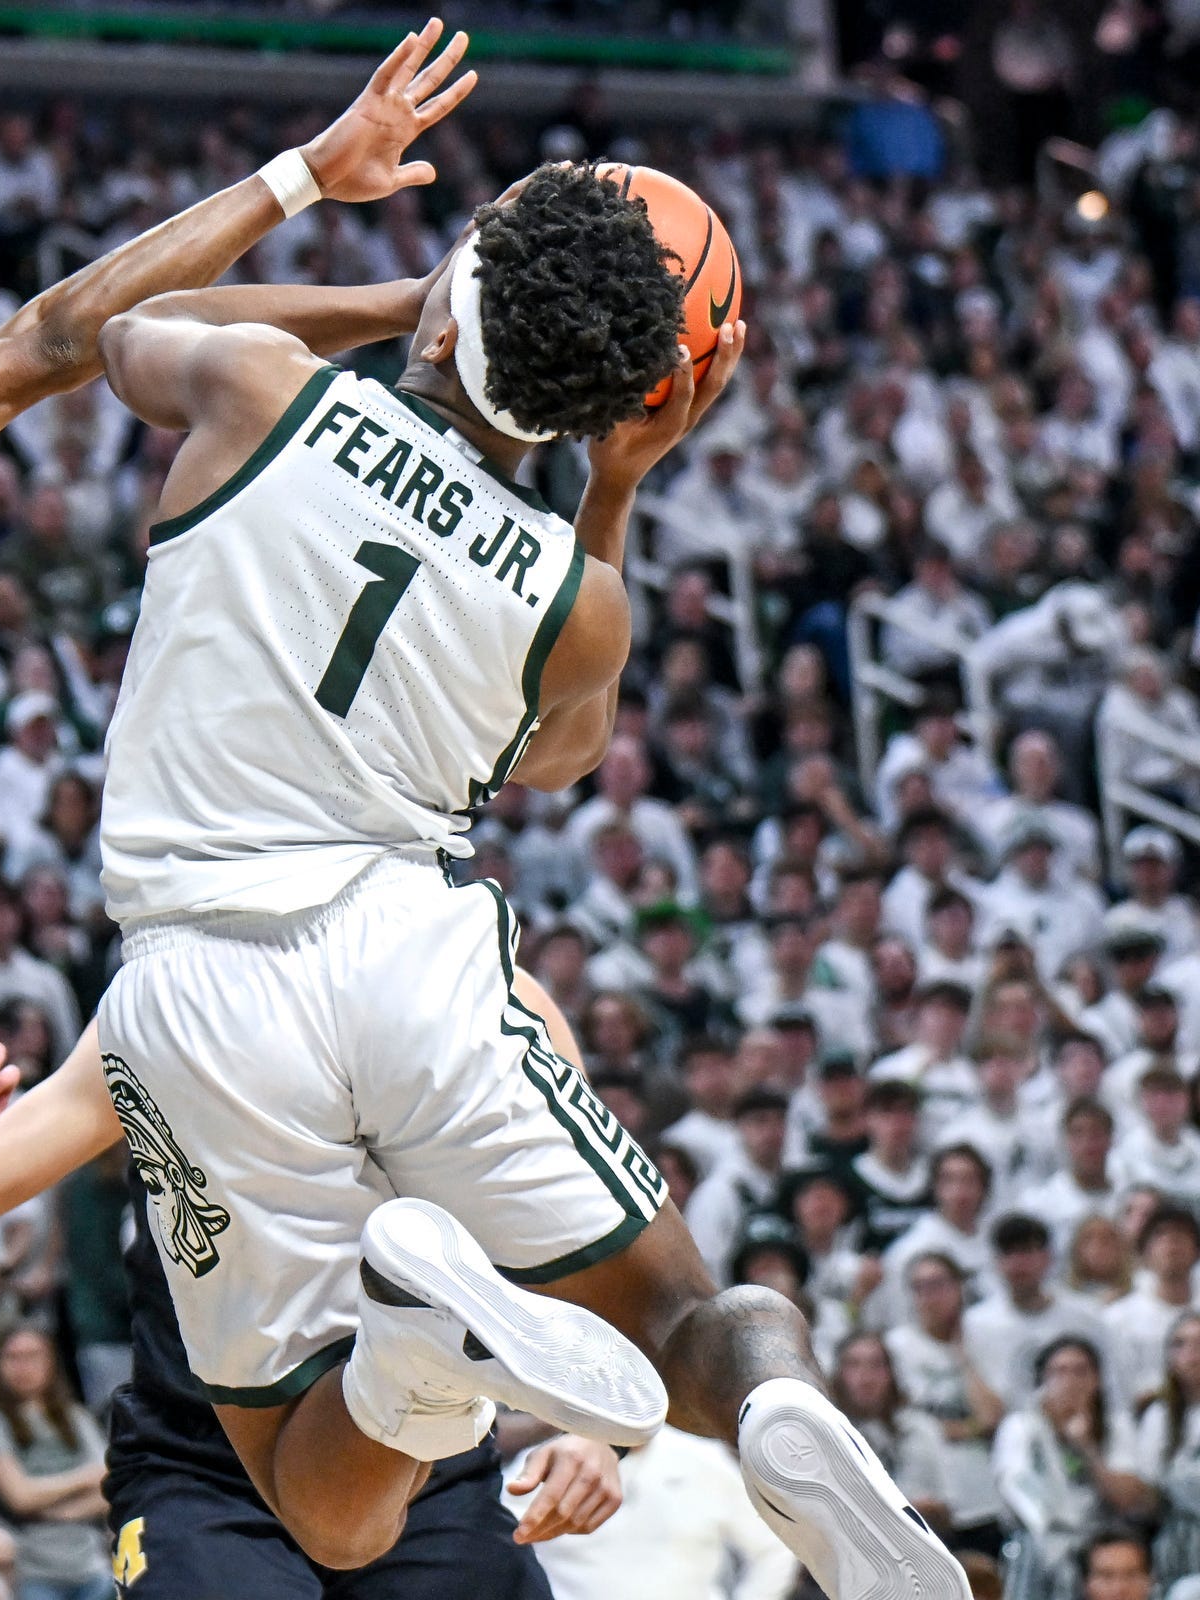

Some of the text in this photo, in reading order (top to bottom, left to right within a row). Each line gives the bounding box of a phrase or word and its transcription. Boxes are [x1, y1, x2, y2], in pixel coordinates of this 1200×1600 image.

[303, 400, 542, 608] FEARS JR.
[313, 540, 422, 719] 1
